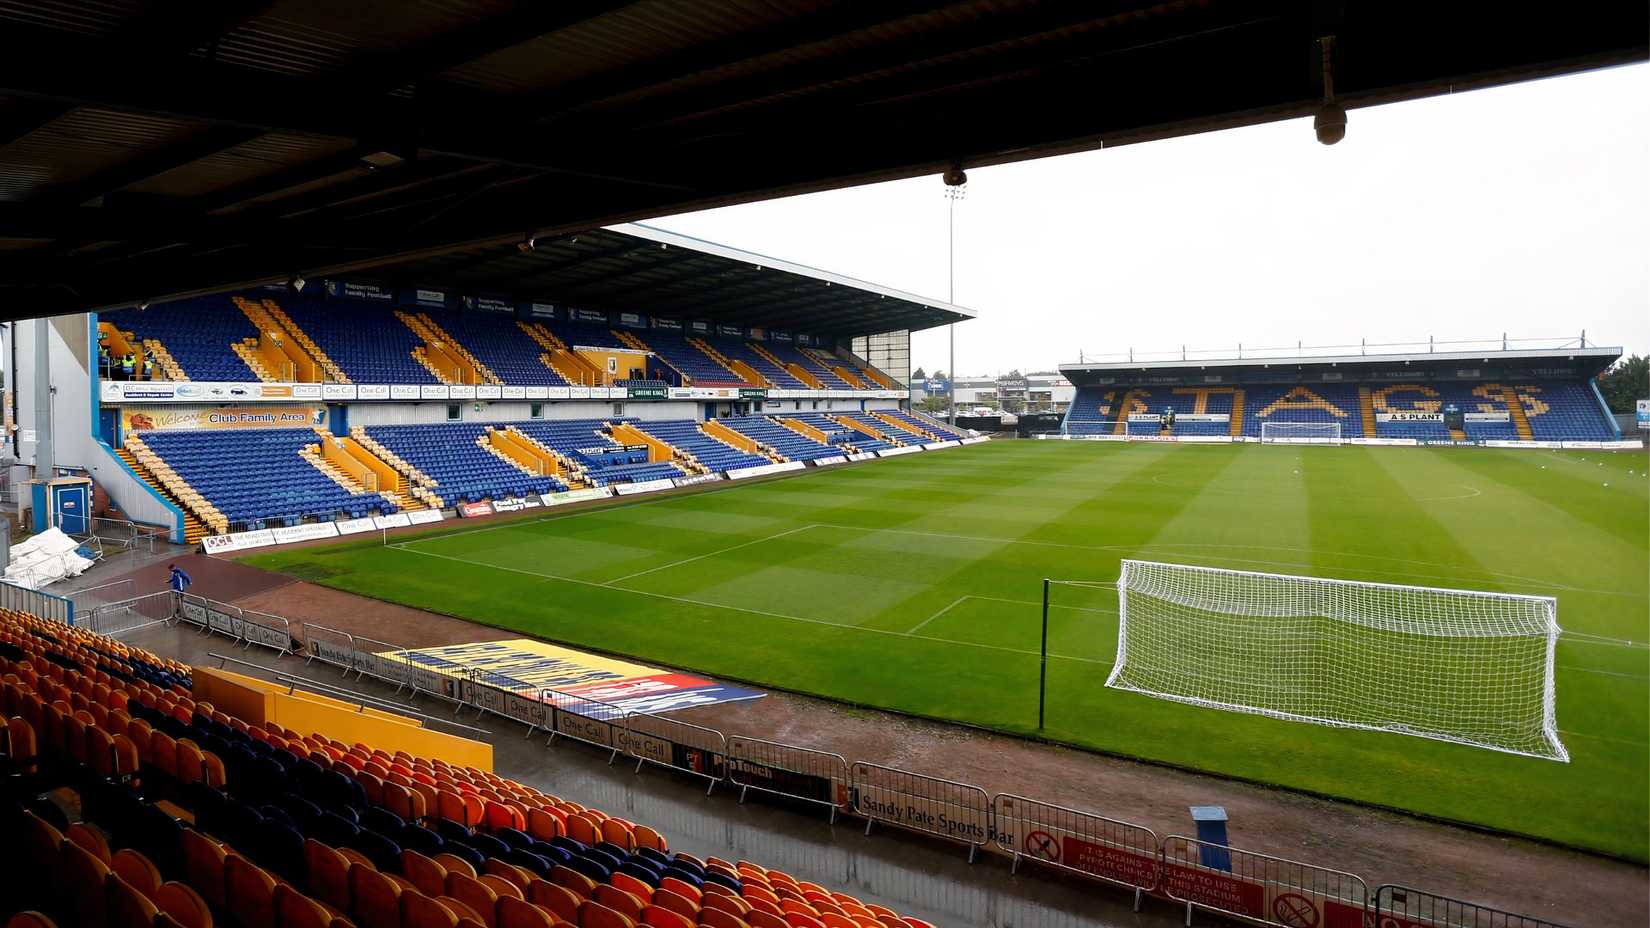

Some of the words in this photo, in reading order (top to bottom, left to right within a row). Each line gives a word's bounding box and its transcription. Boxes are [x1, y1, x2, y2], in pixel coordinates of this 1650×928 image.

[209, 413, 237, 423] Club
[240, 413, 276, 424] Family
[280, 412, 304, 422] Area
[207, 536, 232, 547] OCL
[563, 716, 582, 730] One
[585, 722, 603, 737] Call
[618, 732, 641, 750] One
[643, 739, 664, 756] Call
[863, 794, 903, 818] Sandy
[907, 806, 935, 826] Pate
[938, 814, 985, 839] Sports
[988, 826, 1014, 846] Bar
